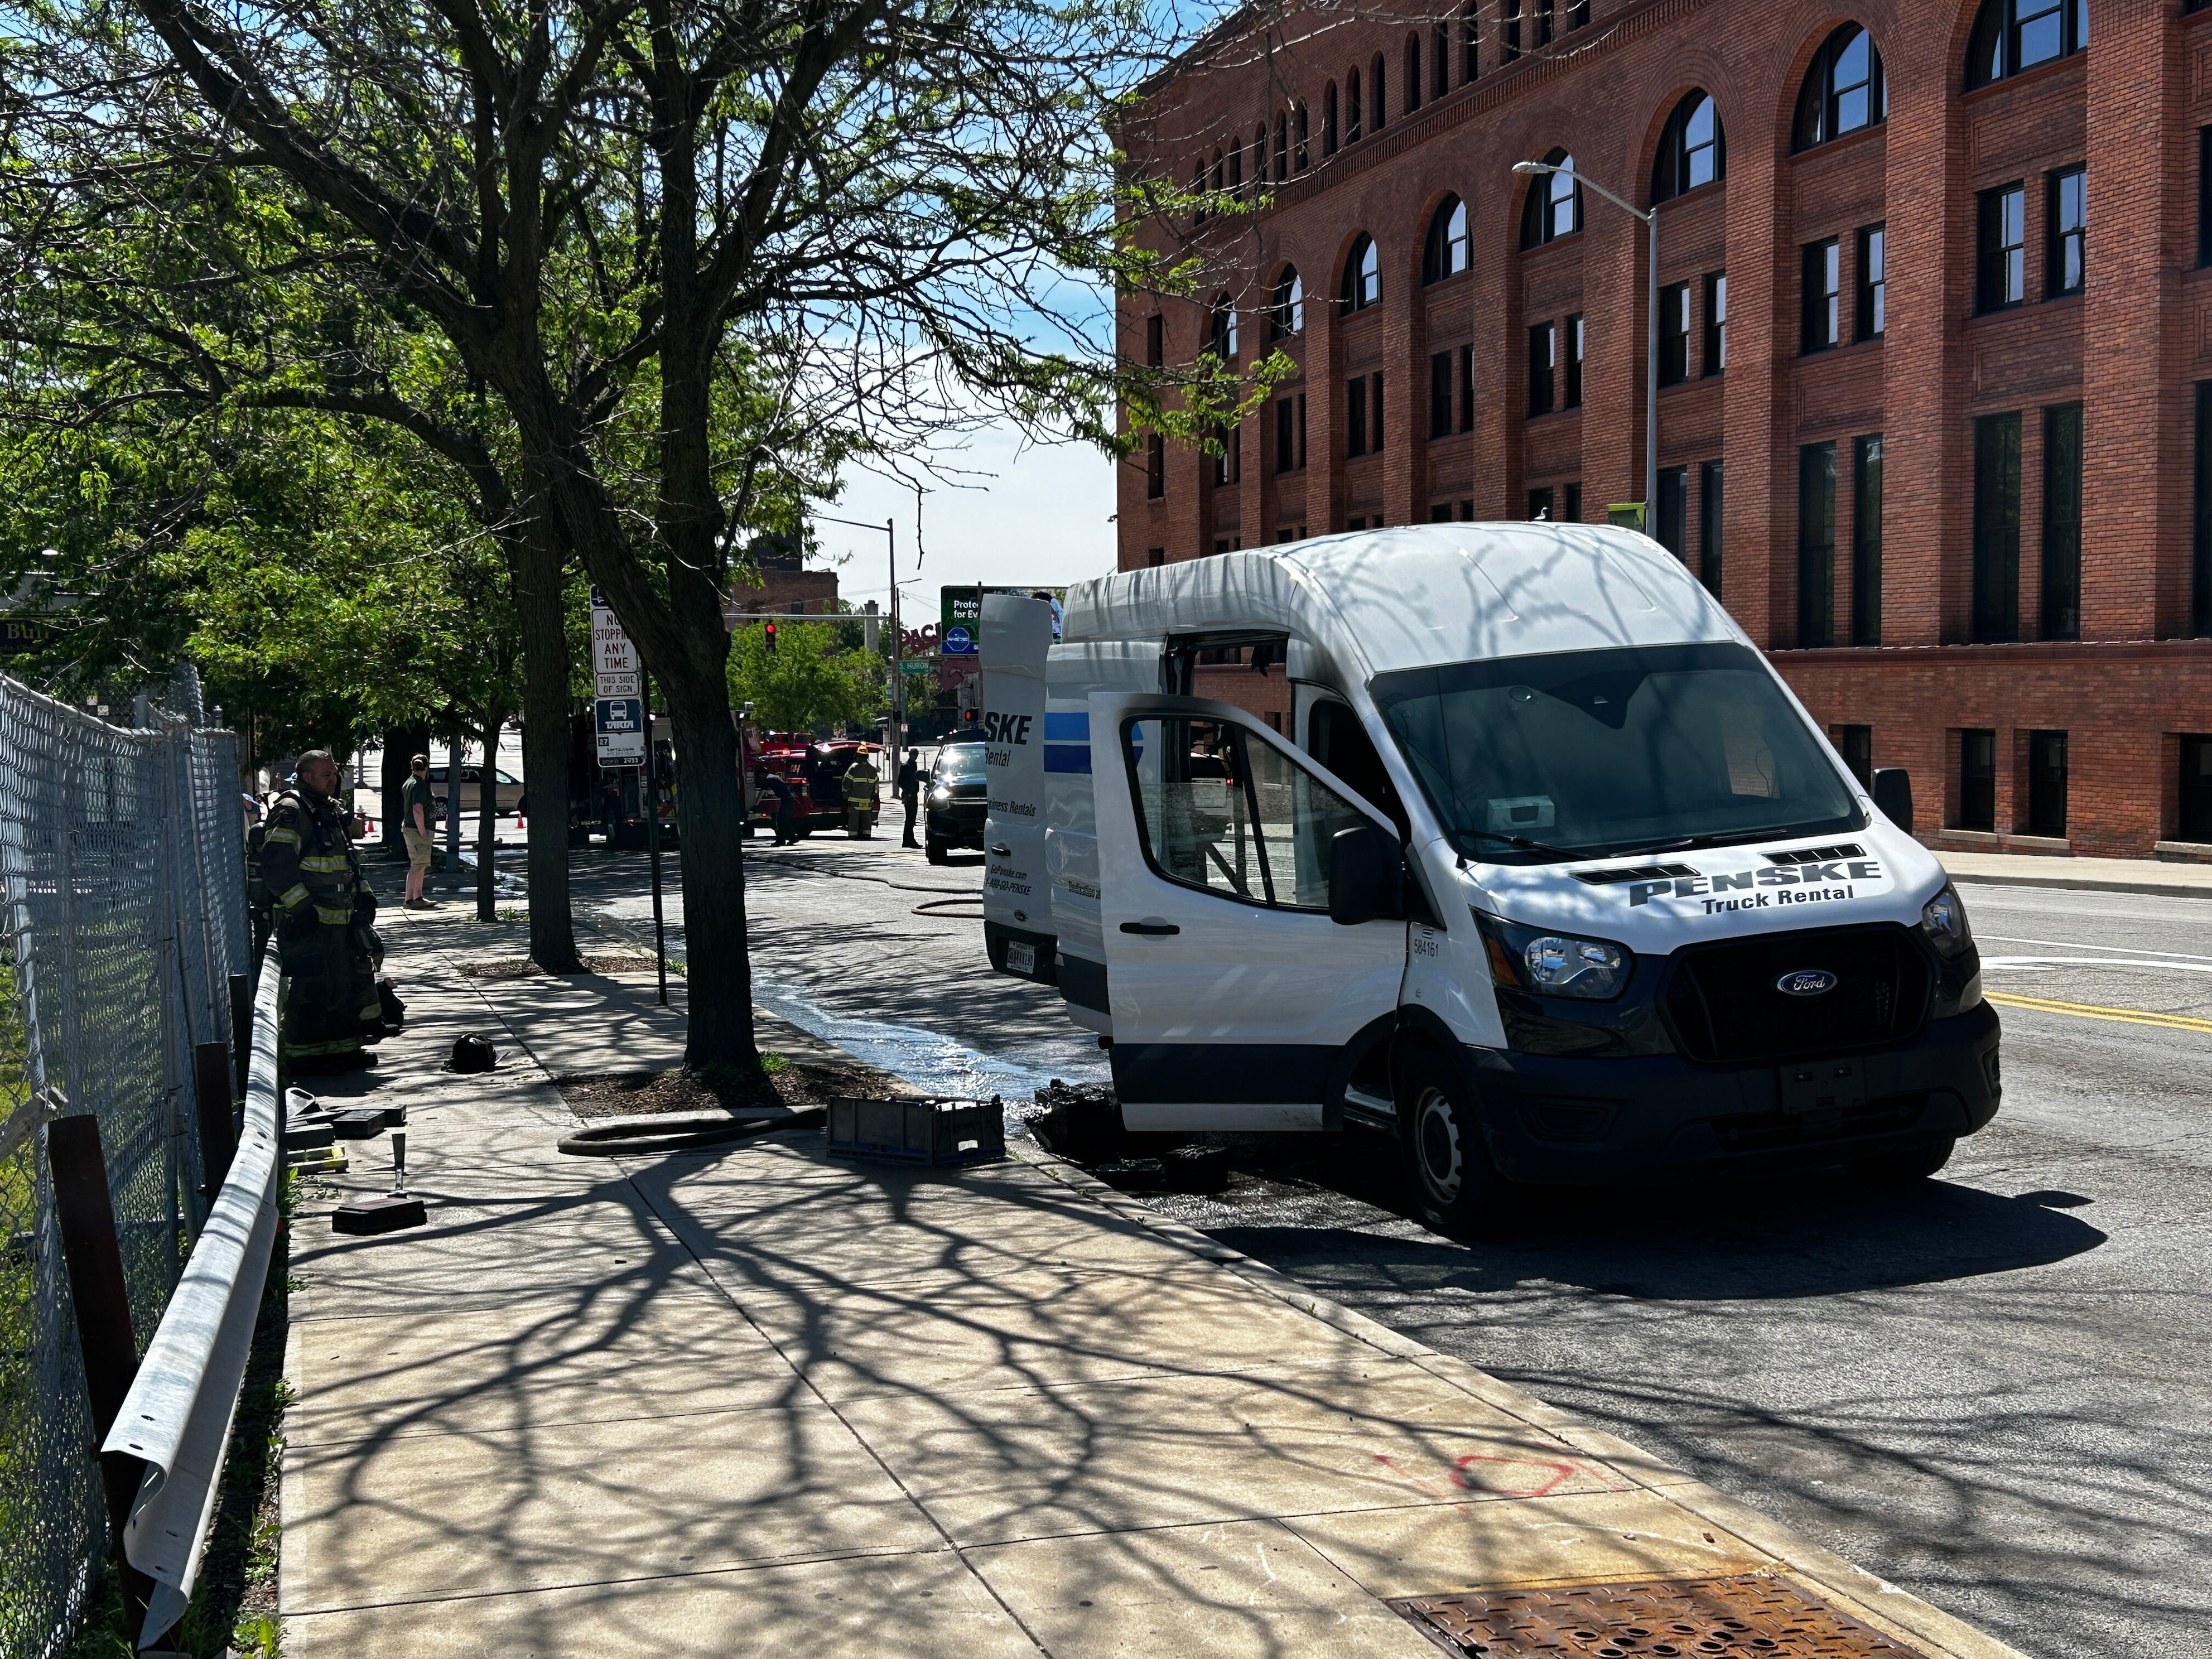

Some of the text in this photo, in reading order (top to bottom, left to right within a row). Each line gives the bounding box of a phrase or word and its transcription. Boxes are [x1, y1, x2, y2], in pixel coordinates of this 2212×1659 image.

[954, 610, 967, 619] for
[605, 643, 626, 654] ANY
[604, 657, 629, 669] TIME
[985, 747, 1011, 767] Rental
[1010, 800, 1036, 817] Rentals
[1630, 861, 1882, 906] PENSKE
[1701, 885, 1854, 915] Truck Rental
[1793, 975, 1826, 992] Ford
